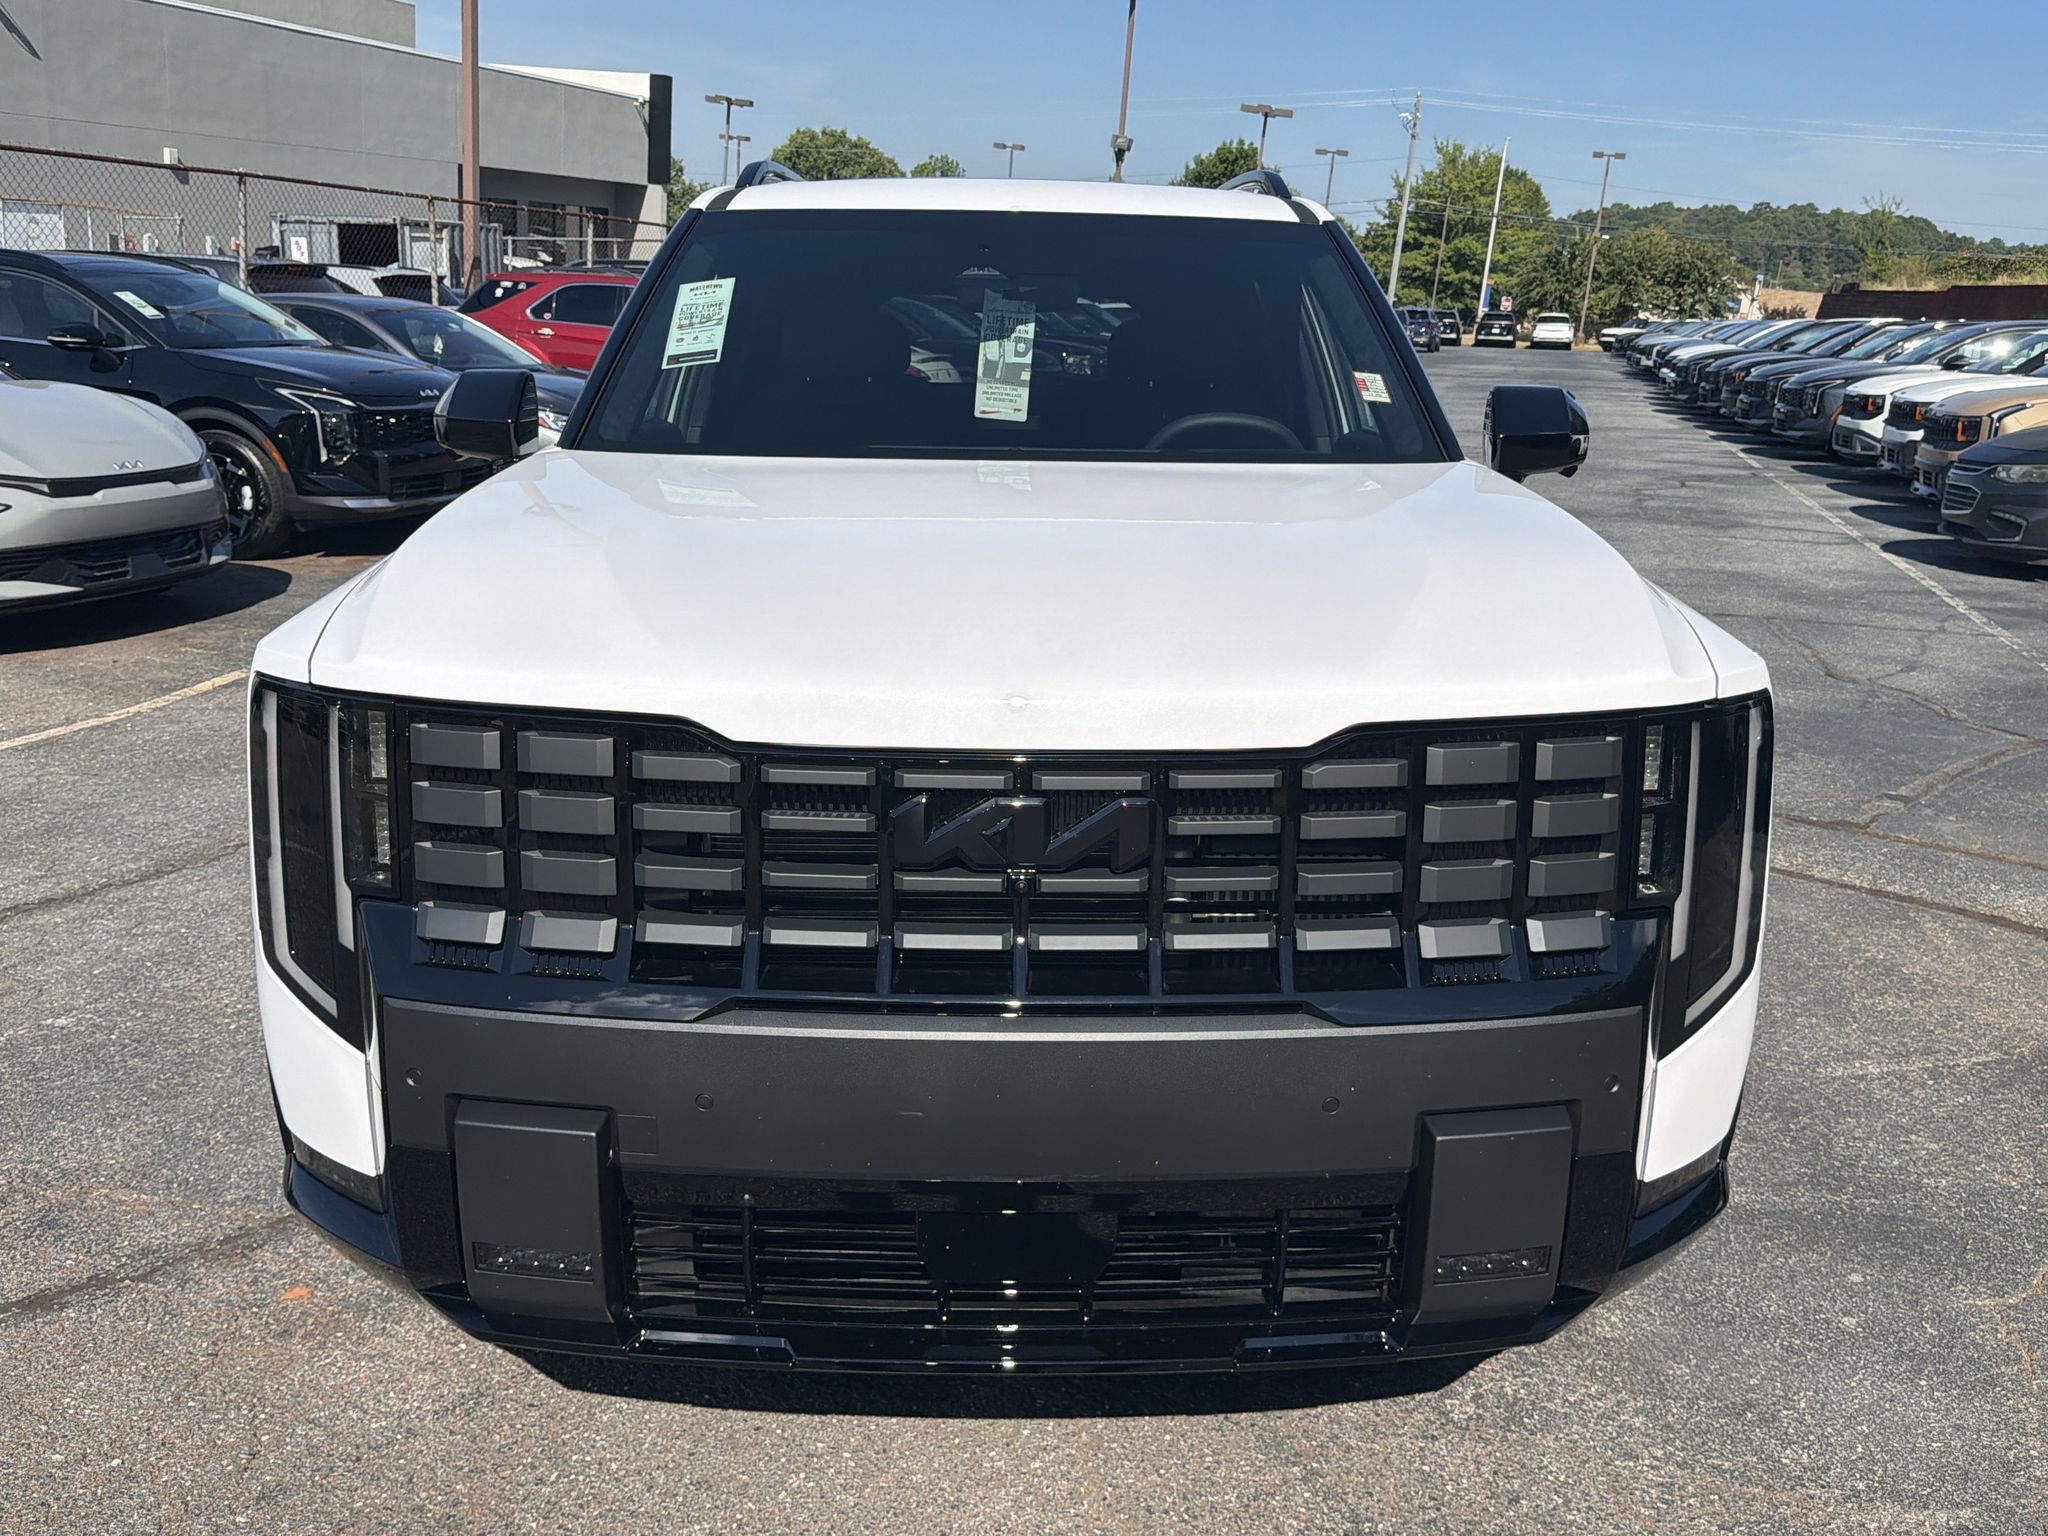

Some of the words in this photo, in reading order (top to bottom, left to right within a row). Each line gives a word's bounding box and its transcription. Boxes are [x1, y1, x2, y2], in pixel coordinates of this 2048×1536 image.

[681, 303, 723, 312] LIFETIME
[679, 312, 721, 320] COVERAGE
[986, 314, 1030, 327] LIFETIME
[985, 333, 1028, 344] COVERAGE
[889, 793, 1154, 873] KIA
